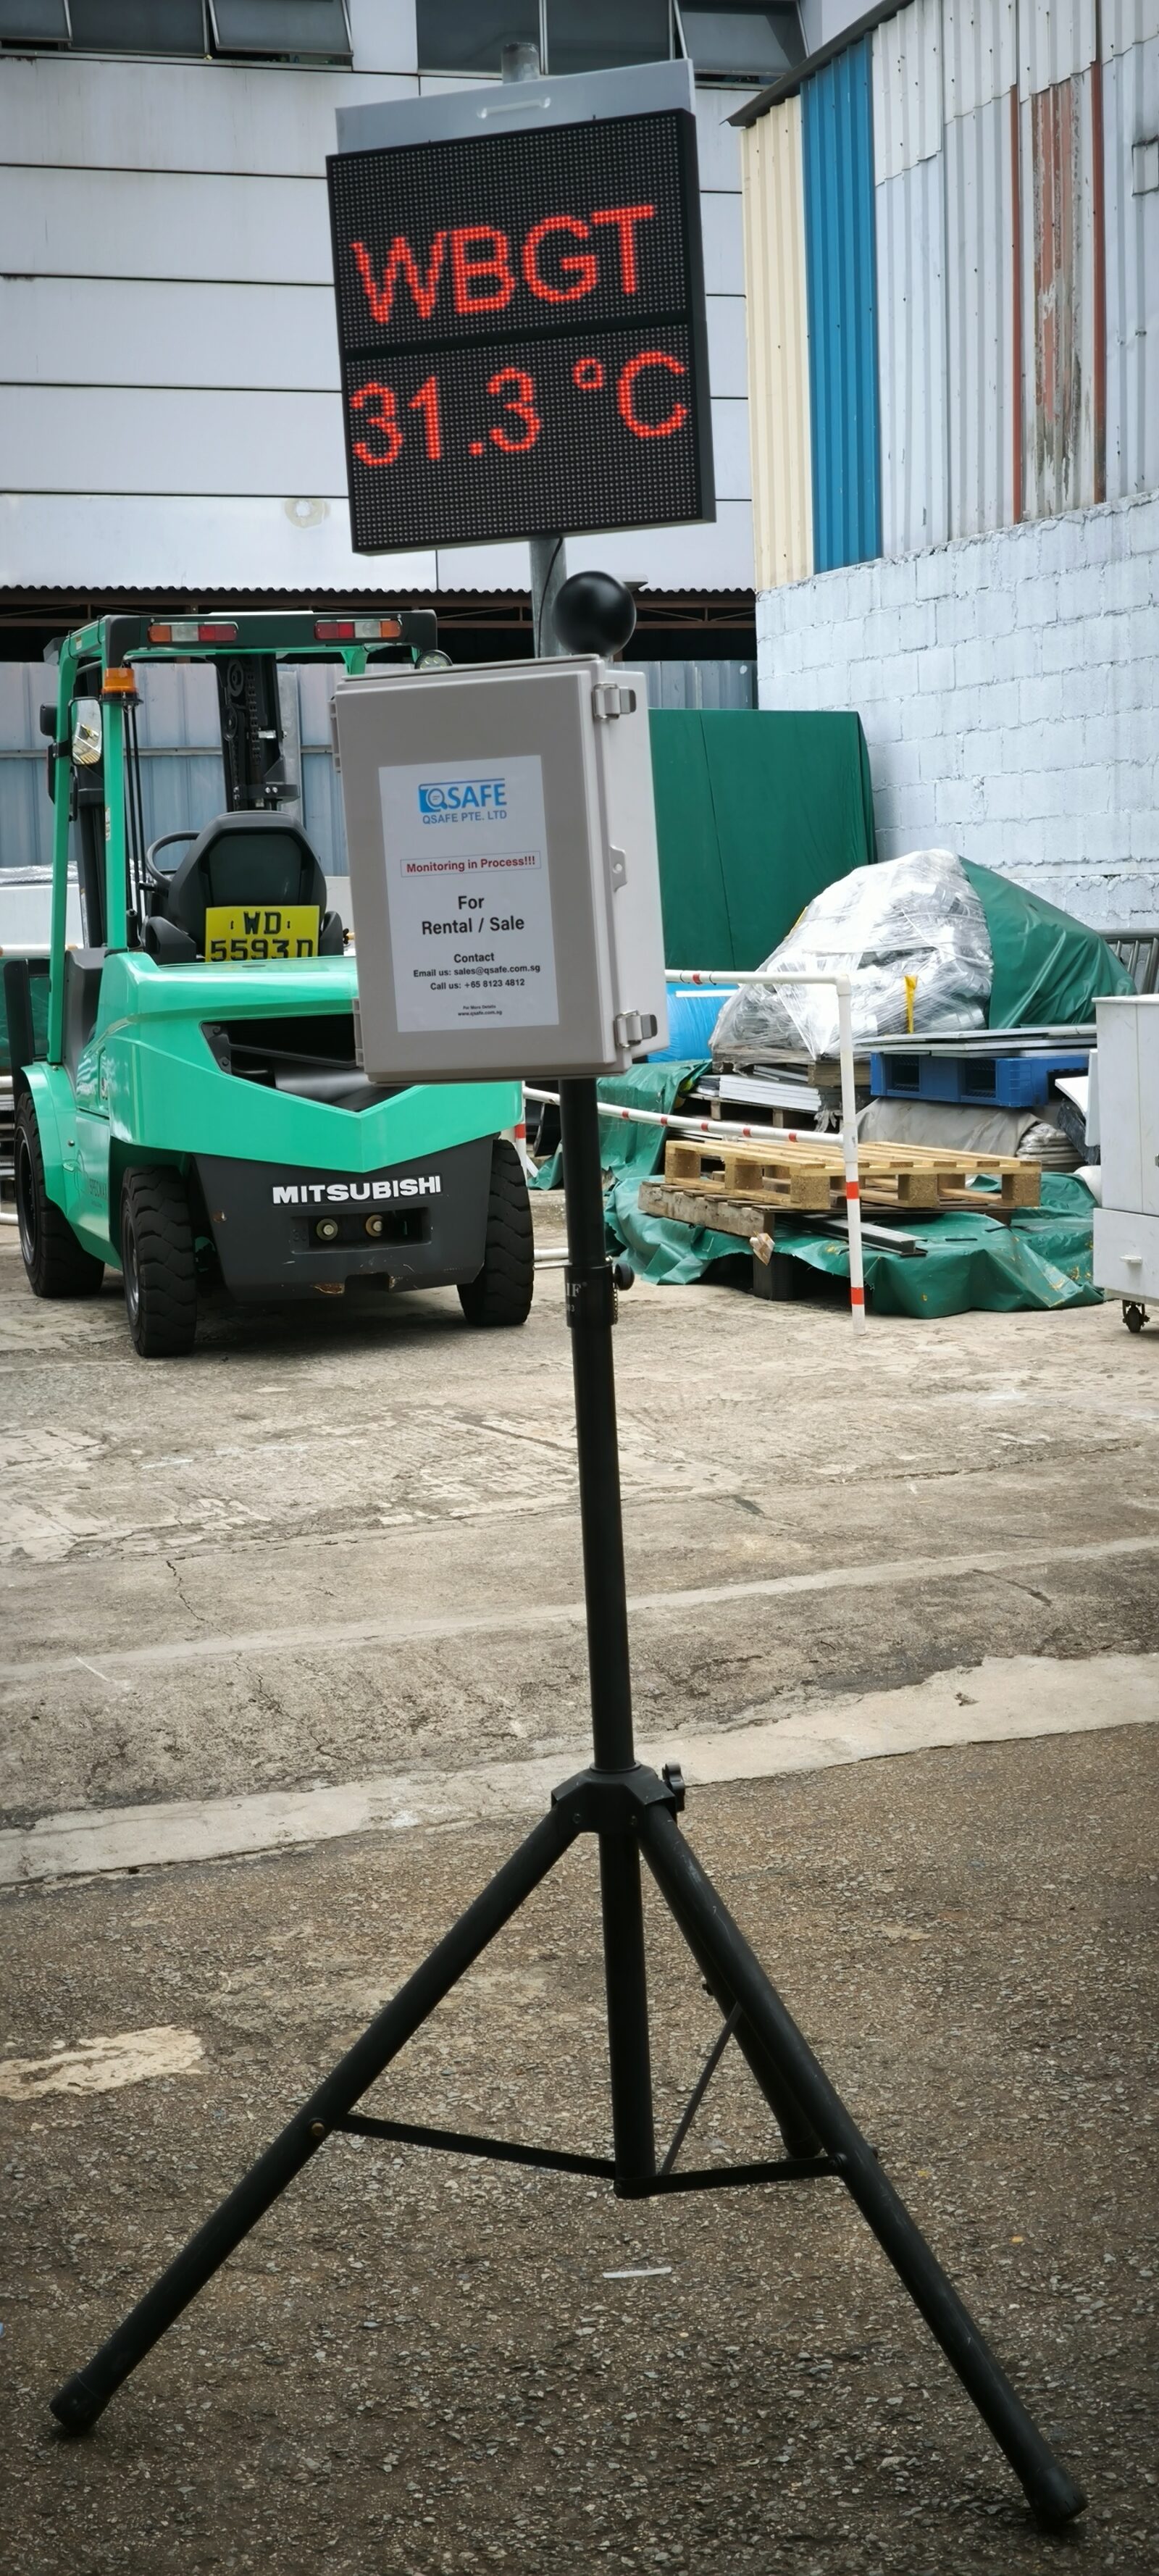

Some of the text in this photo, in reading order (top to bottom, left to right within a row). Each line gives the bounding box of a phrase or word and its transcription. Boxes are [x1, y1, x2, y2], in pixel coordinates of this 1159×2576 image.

[350, 204, 655, 325] WBGT
[350, 351, 688, 467] 31.3 °C
[427, 783, 507, 810] QSAFE
[422, 810, 507, 824] QSAFE PTE. LTD
[406, 856, 536, 872] Monitoring in Process!!!
[458, 895, 485, 910] For
[243, 911, 281, 935] WD
[422, 915, 524, 935] Rental / Sale
[453, 953, 495, 963] Contact
[453, 964, 540, 976] sales@qsafe.com.sg
[430, 982, 446, 990] Call
[464, 980, 481, 989] +65
[272, 1175, 442, 1205] MITSUBISHI
